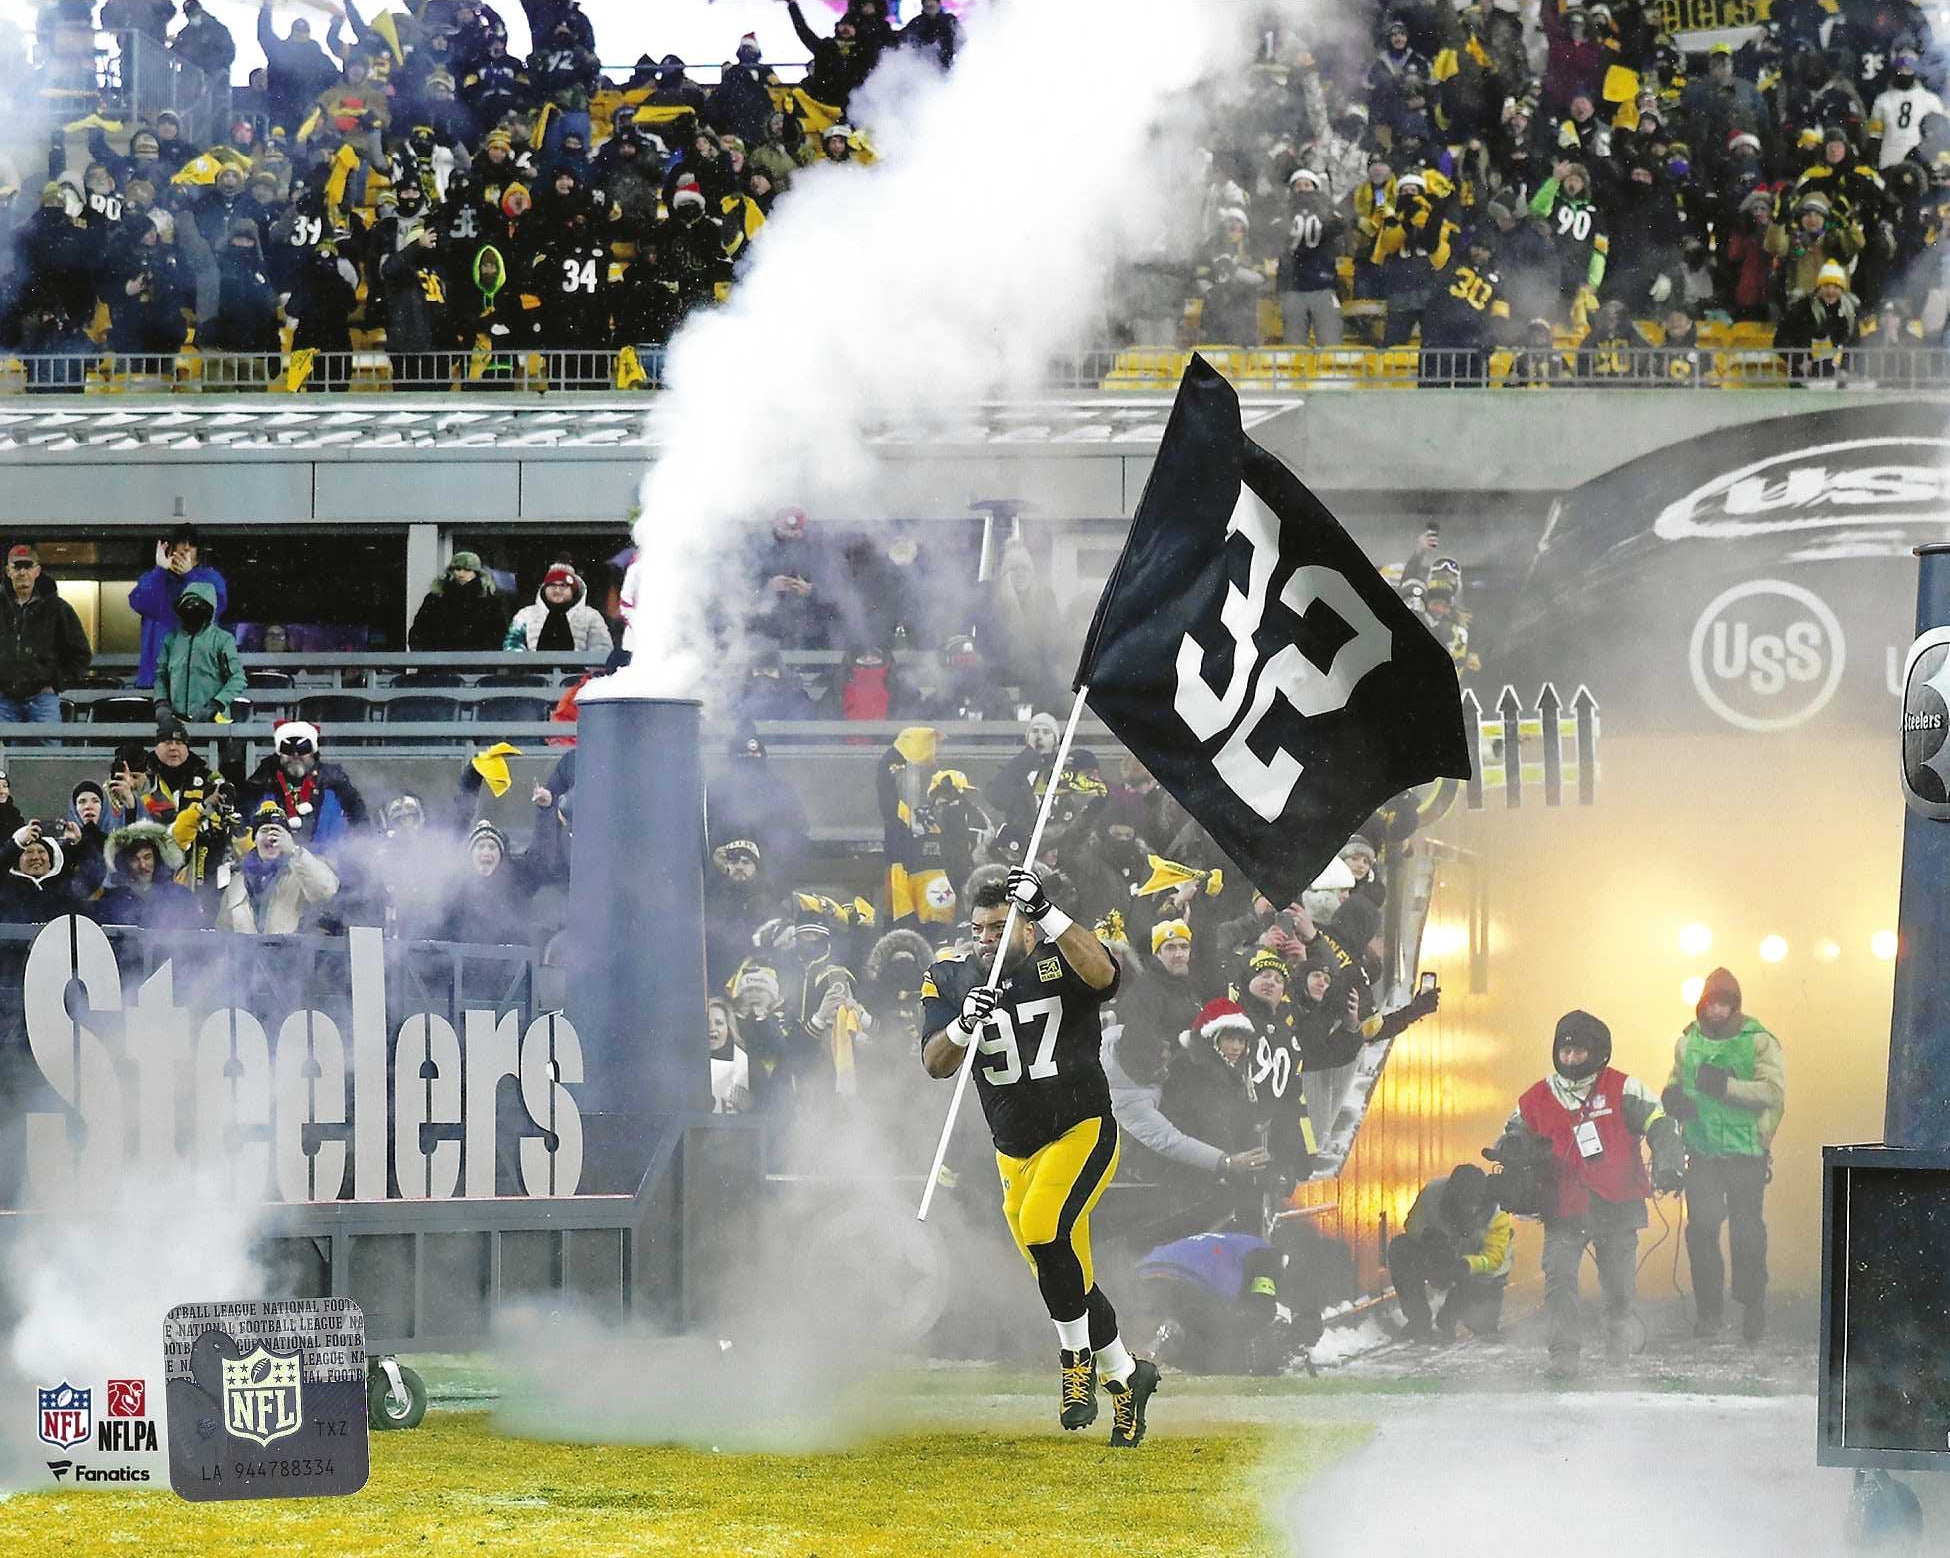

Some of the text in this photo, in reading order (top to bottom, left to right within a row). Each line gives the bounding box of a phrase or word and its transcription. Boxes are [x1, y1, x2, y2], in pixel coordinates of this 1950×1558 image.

[1898, 101, 1912, 128] 8
[1290, 213, 1322, 250] 90
[1557, 205, 1592, 240] 90
[562, 258, 598, 293] 34
[1450, 266, 1493, 310] 30
[1174, 479, 1392, 823] 32
[1712, 620, 1822, 694] USS
[1904, 709, 1942, 733] Steelers
[23, 913, 584, 1201] Steelers
[976, 995, 1063, 1087] 97
[1252, 1036, 1292, 1098] 90
